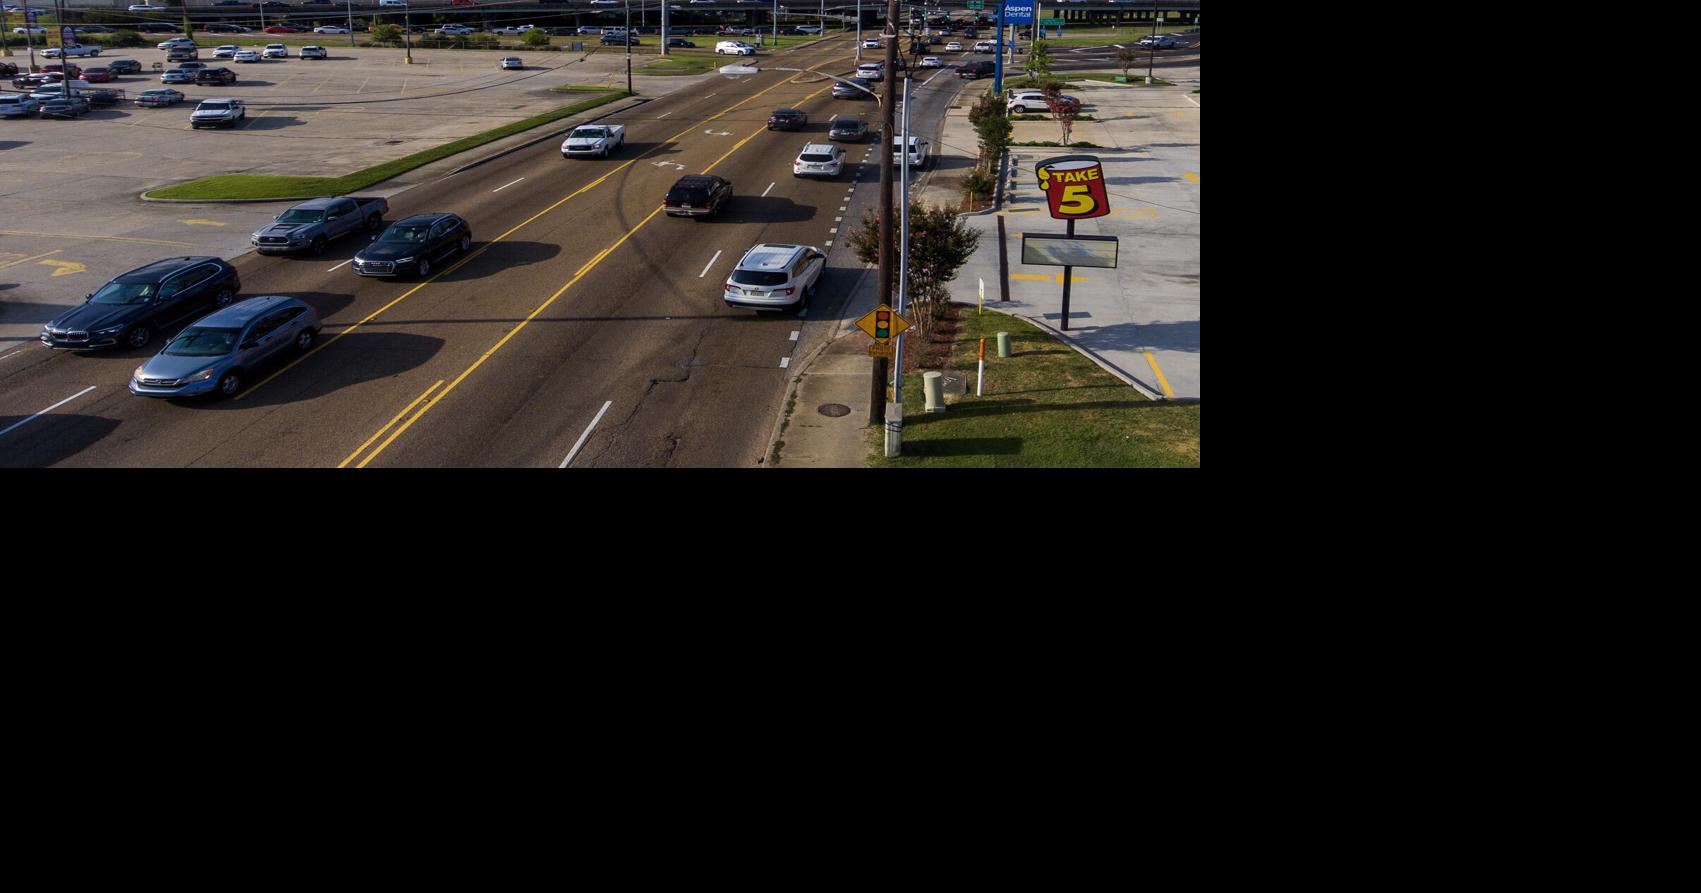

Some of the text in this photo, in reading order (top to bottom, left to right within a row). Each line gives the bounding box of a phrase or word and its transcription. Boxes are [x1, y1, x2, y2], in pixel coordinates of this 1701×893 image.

[1004, 4, 1032, 12] Aspen
[1052, 168, 1099, 183] TAKE
[1058, 184, 1095, 215] 5
